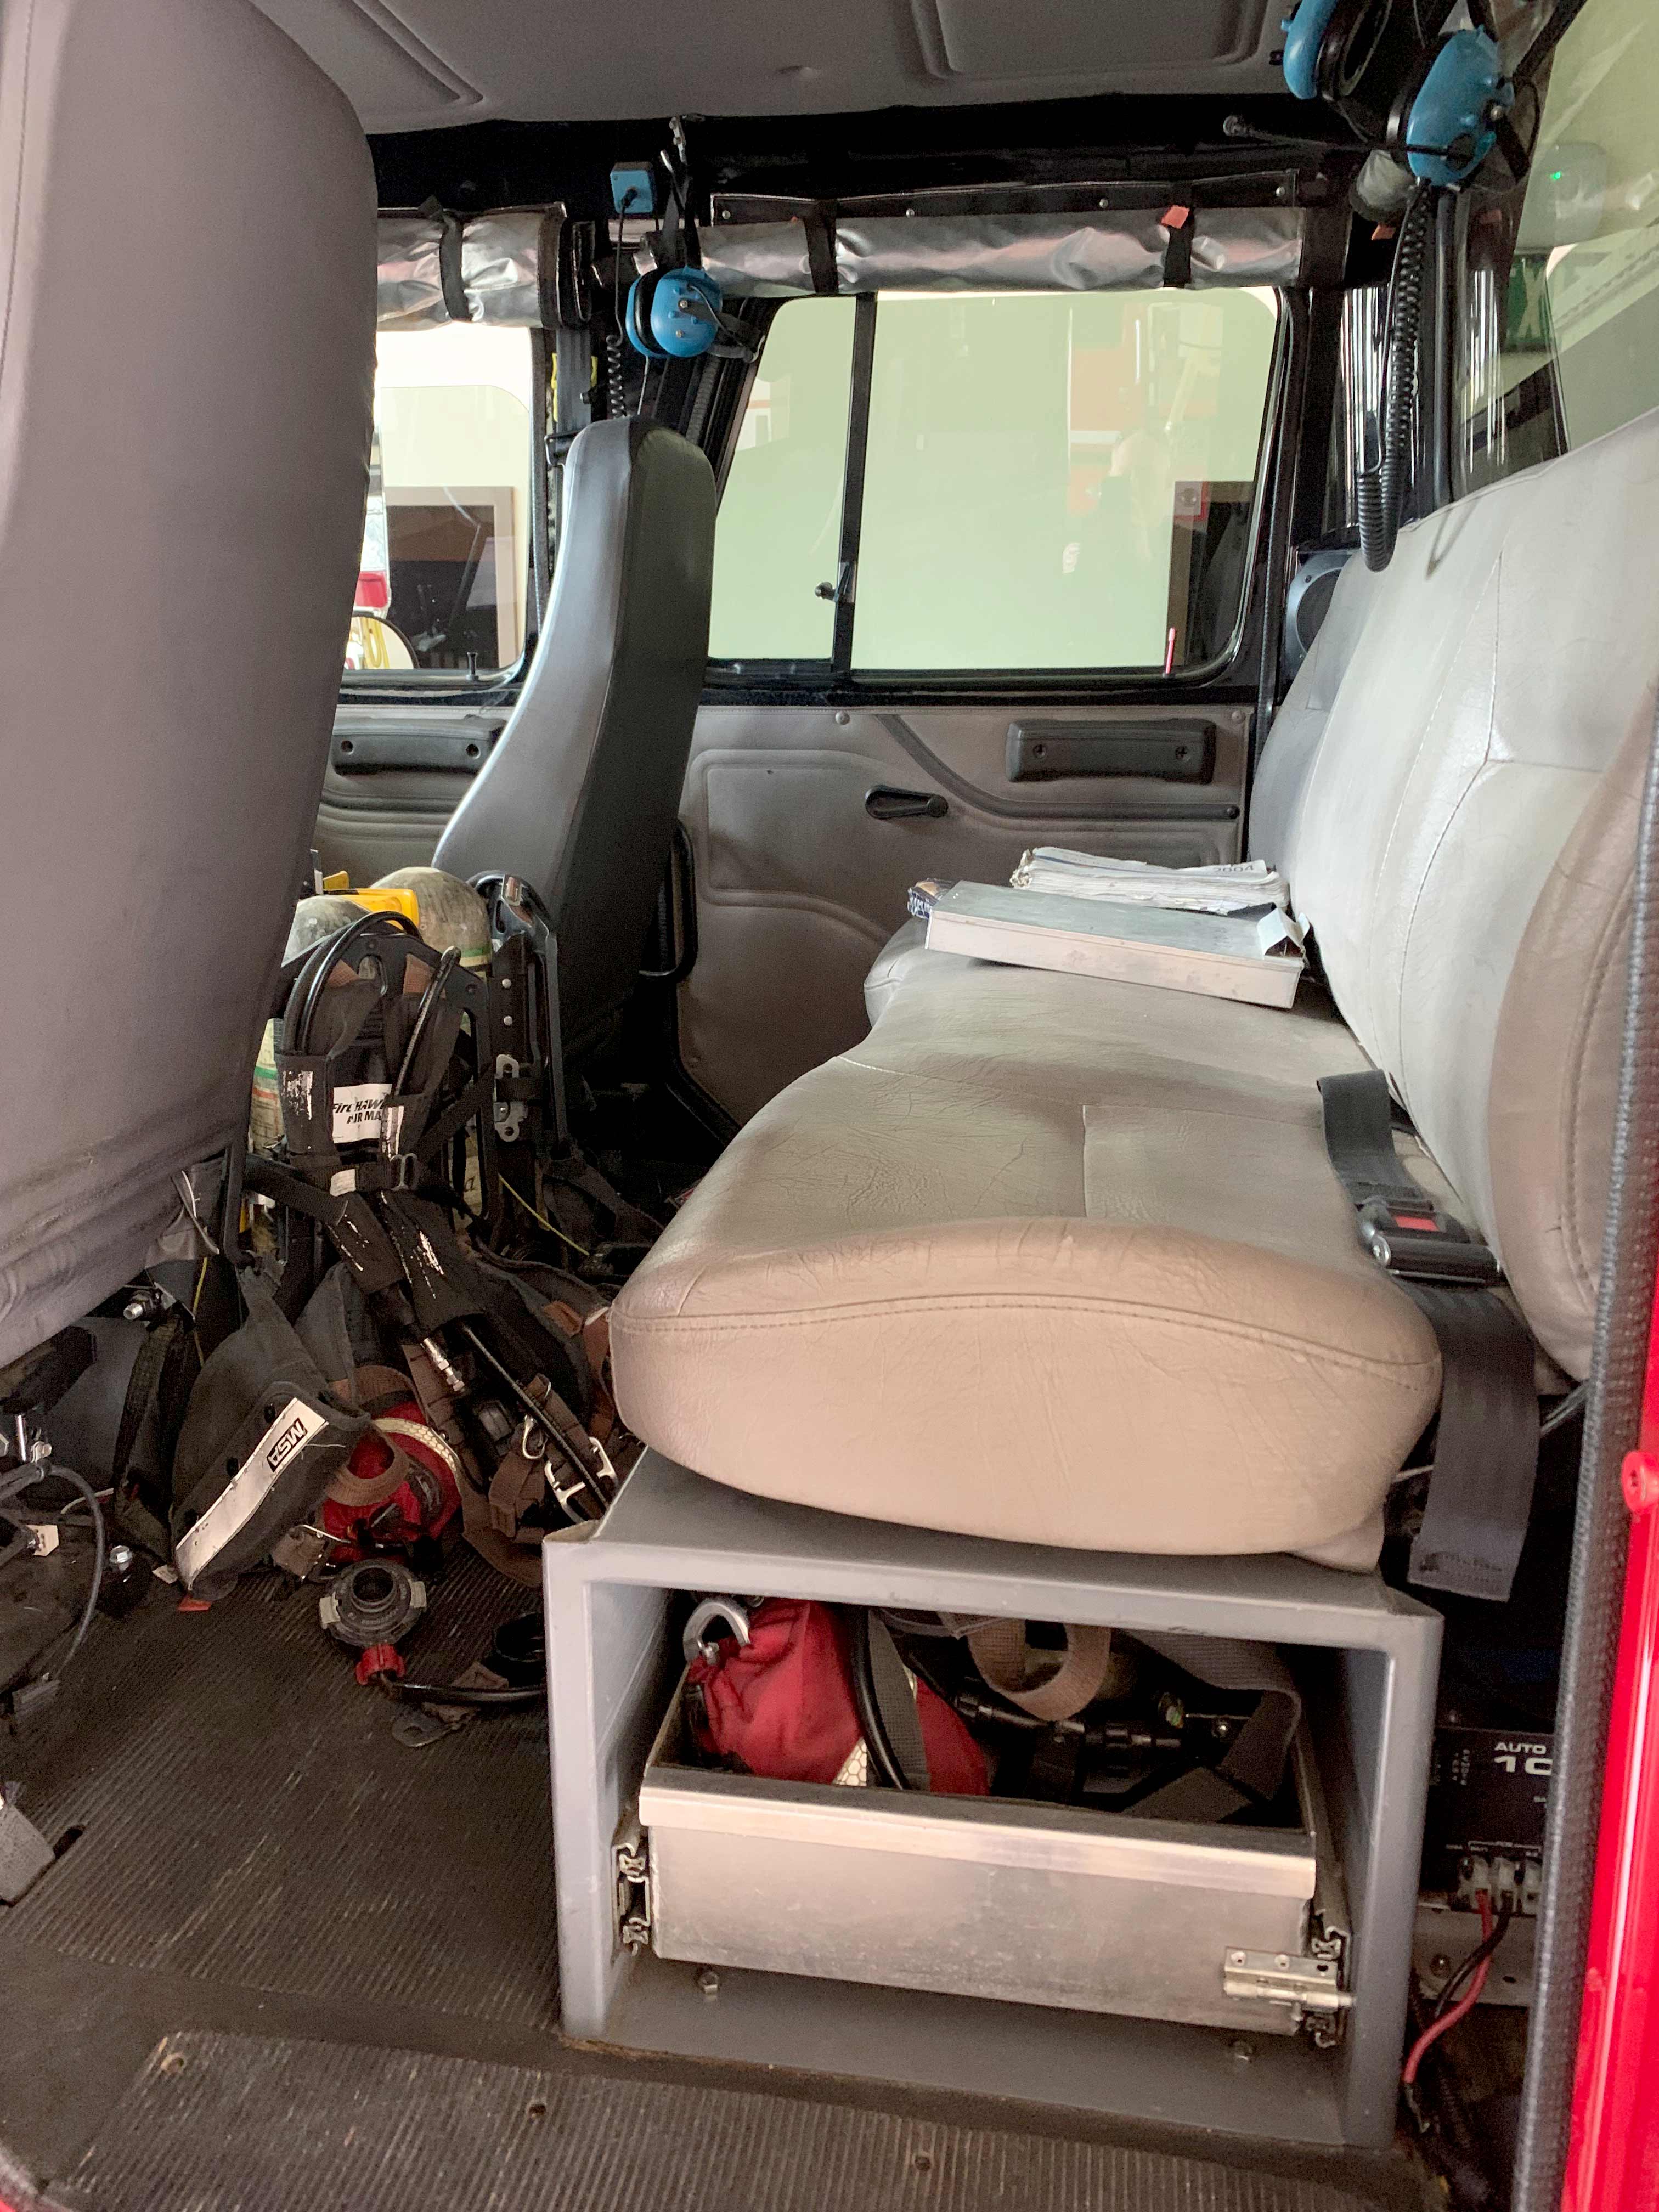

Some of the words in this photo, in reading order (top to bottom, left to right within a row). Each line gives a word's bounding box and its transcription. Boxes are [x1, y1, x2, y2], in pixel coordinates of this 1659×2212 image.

[355, 1099, 384, 1111] HAW
[347, 1113, 363, 1124] AIR
[364, 1111, 381, 1120] MA
[267, 1419, 306, 1468] MSA
[1494, 1741, 1547, 1754] AUTO
